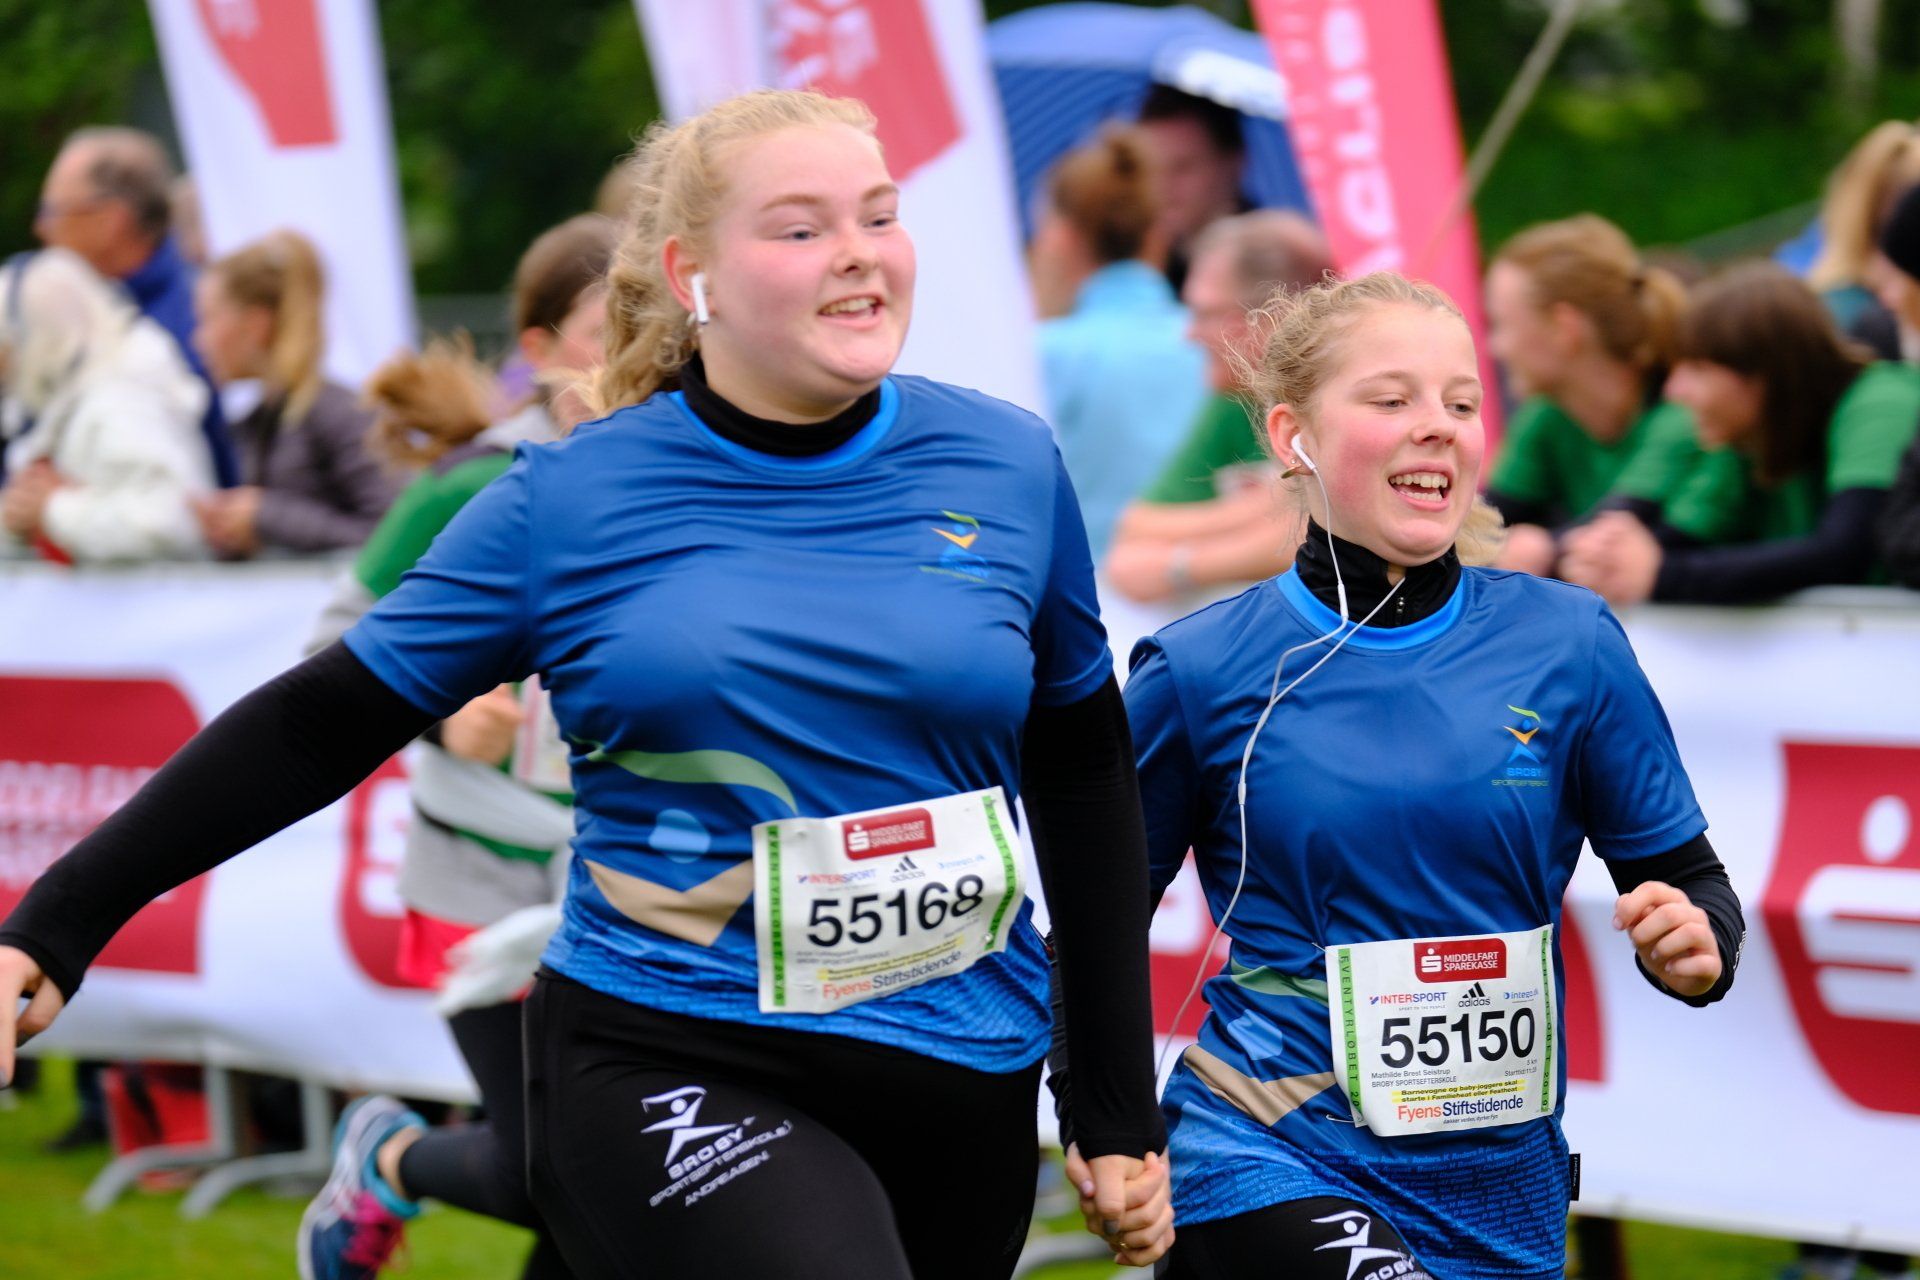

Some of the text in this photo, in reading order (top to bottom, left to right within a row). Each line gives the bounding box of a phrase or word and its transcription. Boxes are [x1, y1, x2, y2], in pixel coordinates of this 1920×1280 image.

[809, 869, 877, 885] INTERSPORT
[807, 874, 984, 947] 55168
[1443, 951, 1499, 963] MIDDELFART
[1444, 960, 1498, 972] SPAREKASSE
[1380, 992, 1448, 1005] INTERSPORT
[1458, 998, 1491, 1008] adidas
[1340, 955, 1359, 1081] EVENTYRLØBET
[1380, 1007, 1535, 1069] 55150
[1371, 1071, 1402, 1079] Mathilde
[1395, 1075, 1457, 1087] SPORTSEFTERSKOLE
[1401, 1088, 1447, 1096] Barnevogne
[1541, 1071, 1550, 1107] 2019
[667, 1127, 743, 1180] BROBY
